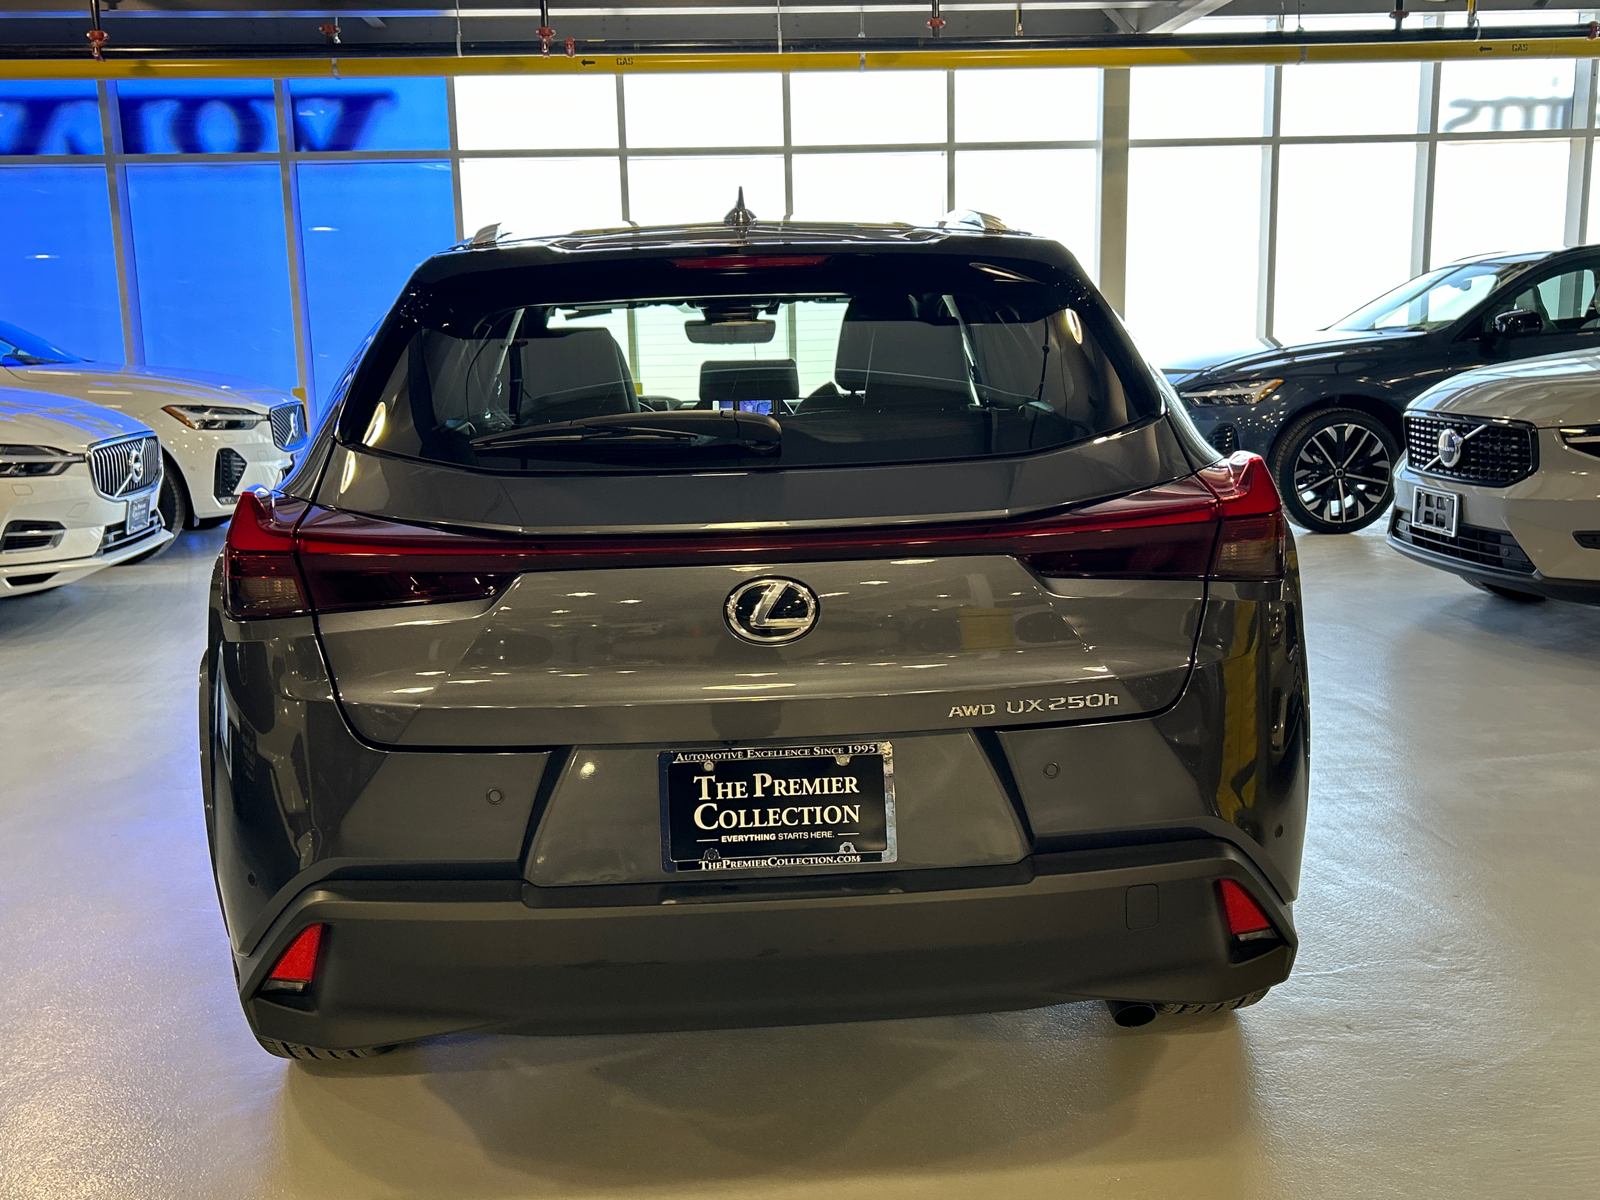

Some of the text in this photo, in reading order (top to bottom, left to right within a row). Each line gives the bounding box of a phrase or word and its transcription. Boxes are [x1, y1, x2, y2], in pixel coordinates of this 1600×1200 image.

[1512, 44, 1528, 52] GAS
[616, 57, 634, 66] GAS
[948, 693, 1119, 718] AWD UX 250h
[675, 744, 876, 762] AUTOMOTIVE EXCELLENCE SINCE 1995
[693, 773, 860, 801] THE PREMIER
[693, 803, 861, 830] COLLECTION
[721, 831, 835, 843] EVERYTHING STARTS HERE.
[698, 855, 862, 870] THEPREMIERCOLLECTION.COM
